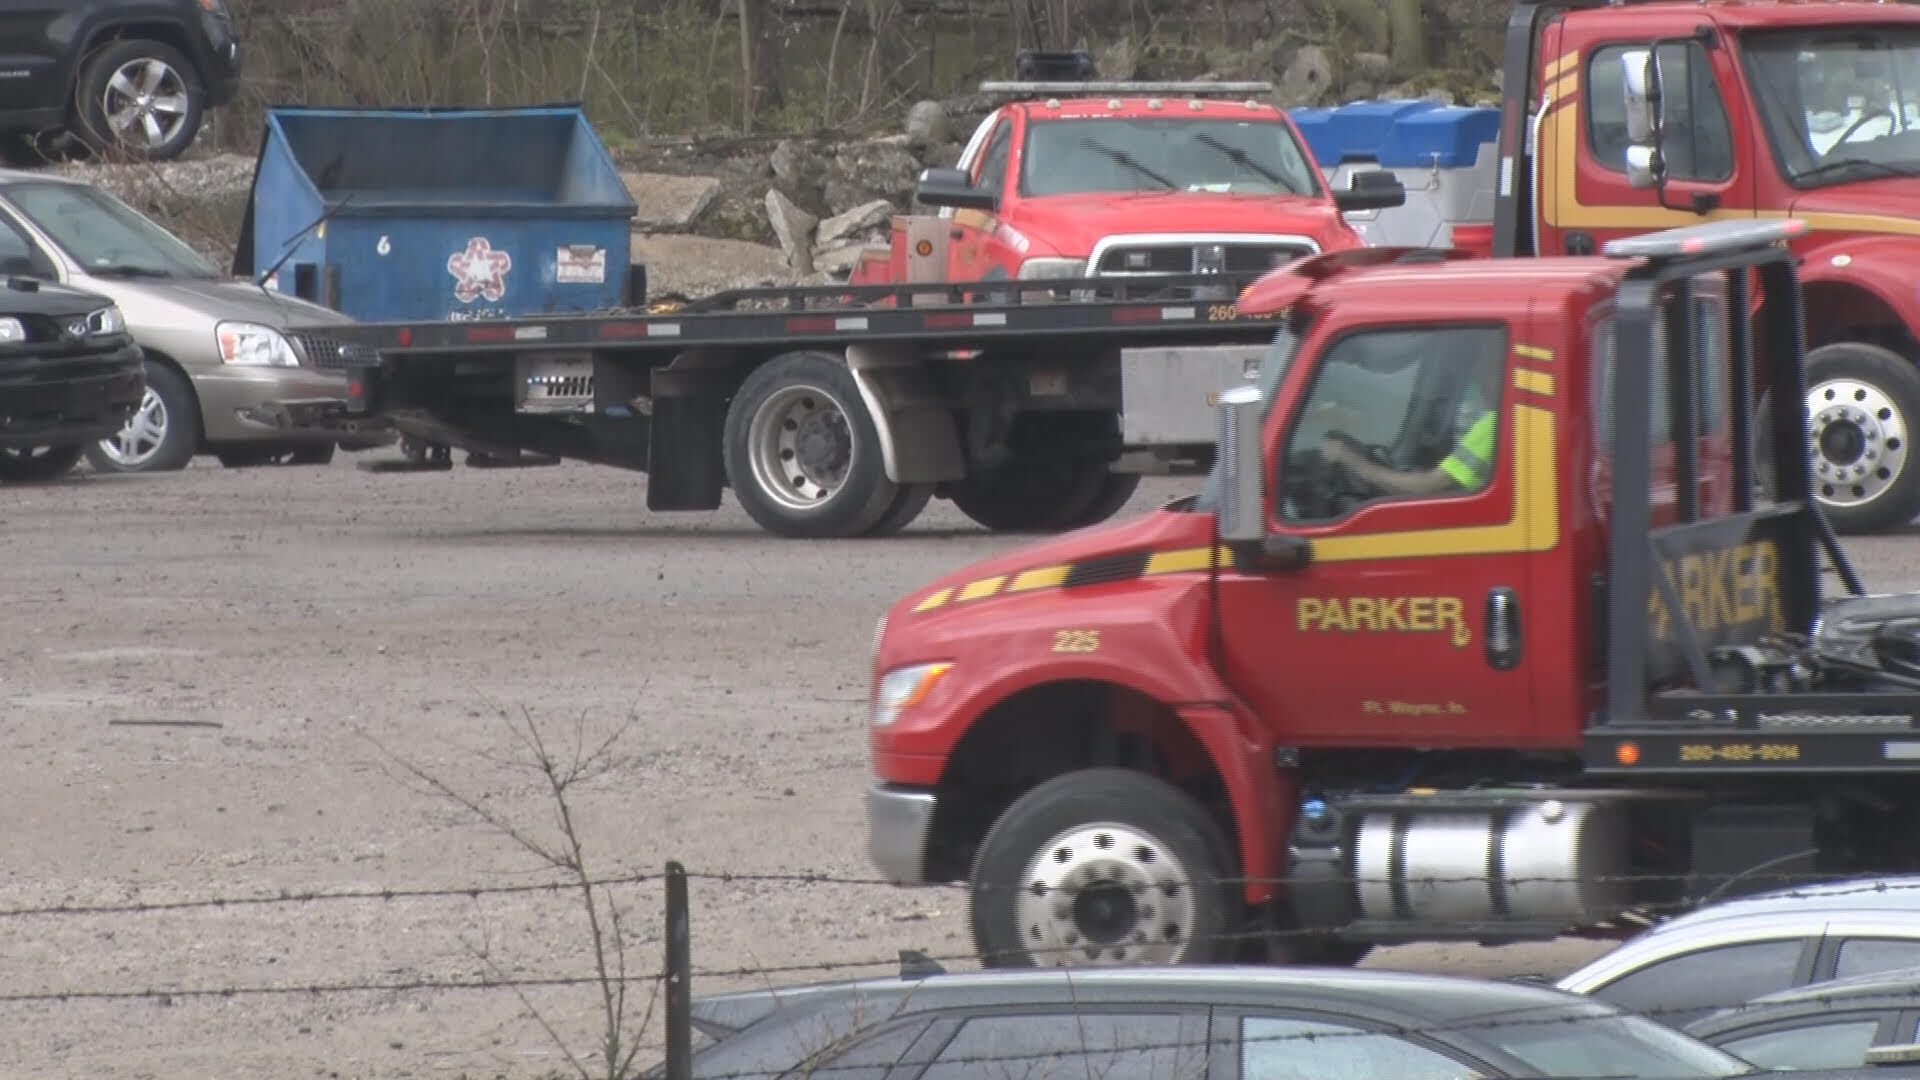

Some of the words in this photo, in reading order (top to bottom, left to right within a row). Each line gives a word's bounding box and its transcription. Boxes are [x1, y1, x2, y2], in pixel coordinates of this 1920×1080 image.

[377, 234, 391, 256] 6
[1297, 597, 1472, 646] PARKER
[1052, 630, 1102, 652] 225
